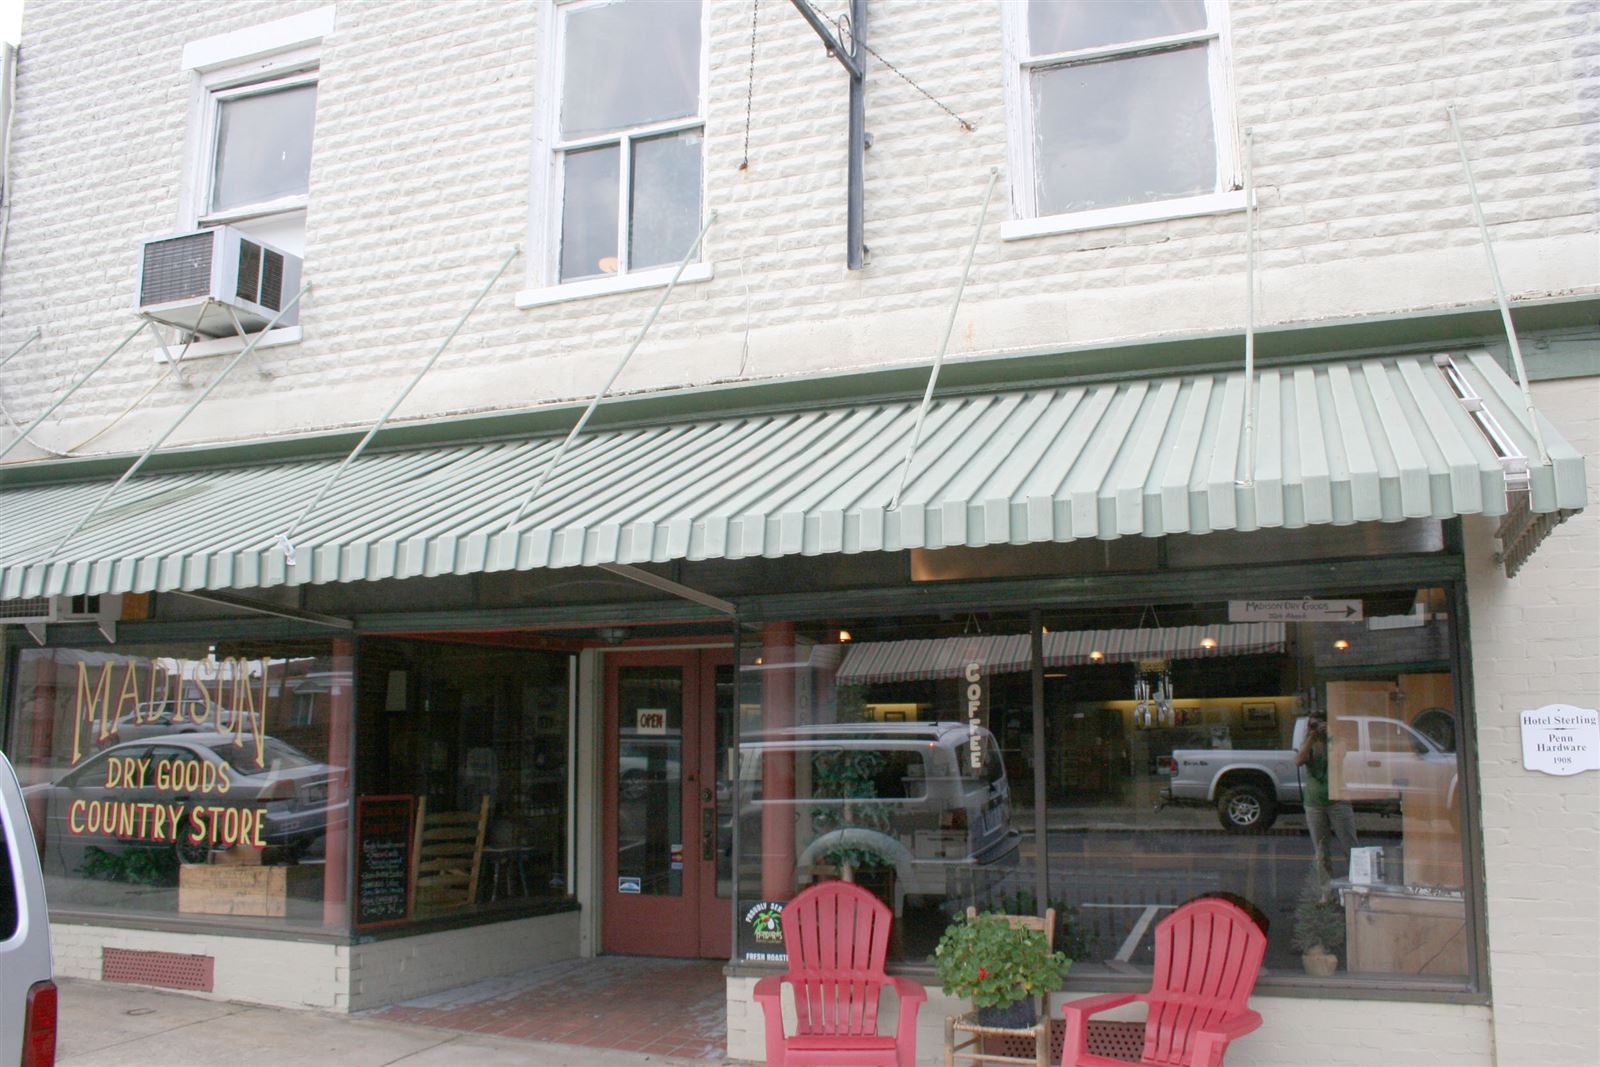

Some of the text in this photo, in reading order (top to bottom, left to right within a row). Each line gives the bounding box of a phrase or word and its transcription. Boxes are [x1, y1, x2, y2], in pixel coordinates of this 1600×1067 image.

[71, 656, 271, 768] MADISON
[965, 662, 982, 769] COFFEE
[640, 713, 664, 729] OPEN
[1523, 715, 1597, 726] Hotel Sterling
[1548, 733, 1573, 743] Penn
[1537, 743, 1587, 752] Hardware
[1553, 756, 1572, 764] 1908
[104, 756, 231, 793] DRY GOODS
[68, 799, 269, 848] COUNTRY STORE
[770, 902, 784, 913] SER
[745, 952, 789, 962] FRESH ROAST
